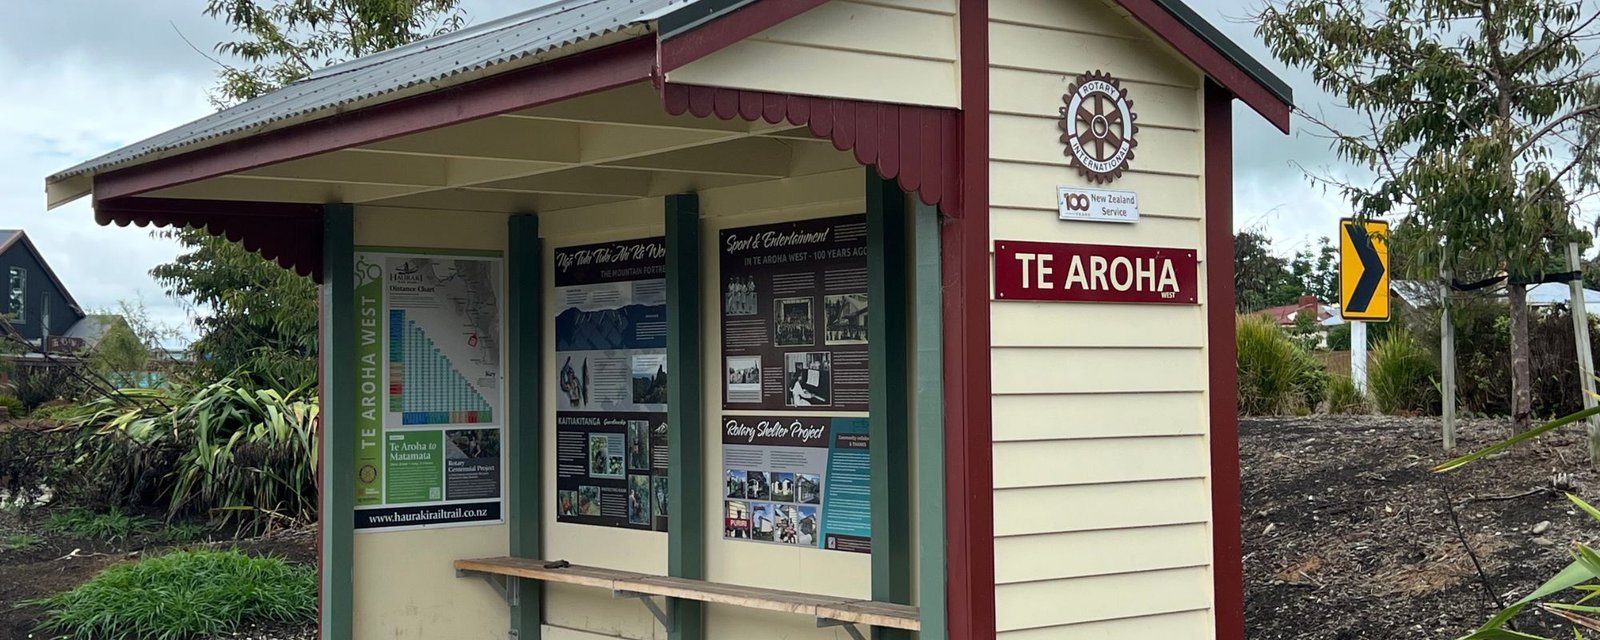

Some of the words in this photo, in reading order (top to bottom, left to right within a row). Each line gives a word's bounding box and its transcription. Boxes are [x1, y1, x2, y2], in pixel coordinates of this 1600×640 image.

[1082, 81, 1116, 96] ROTARY
[1072, 142, 1128, 171] INTERNATIONAL
[1063, 192, 1090, 212] 100
[1091, 193, 1107, 203] New
[1108, 194, 1135, 205] Zealand
[1101, 206, 1127, 217] Service
[726, 233, 752, 254] Sport
[751, 233, 762, 249] &
[762, 227, 830, 248] Entertainment
[744, 257, 752, 266] IN
[753, 256, 761, 265] TE
[763, 254, 788, 265] AROHA
[789, 251, 807, 262] WEST
[814, 250, 826, 260] 100
[827, 247, 851, 259] YEARS
[600, 269, 612, 278] THE
[612, 267, 643, 277] MOUNTAIN
[1015, 252, 1054, 289] TE
[1064, 254, 1180, 292] AROHA
[389, 285, 417, 293] Distance
[417, 285, 435, 293] Chart
[1161, 291, 1176, 299] WEST
[361, 296, 376, 346] WEST
[361, 353, 376, 420] AROHA
[361, 428, 376, 449] TE
[725, 419, 756, 443] Rotary
[757, 421, 789, 439] Shelter
[789, 421, 825, 443] Project
[389, 442, 400, 451] Te
[400, 441, 427, 451] Aroha
[428, 442, 437, 450] to
[389, 451, 431, 461] Matamata
[368, 508, 488, 524] www.haurakirailtrail.co.nz
